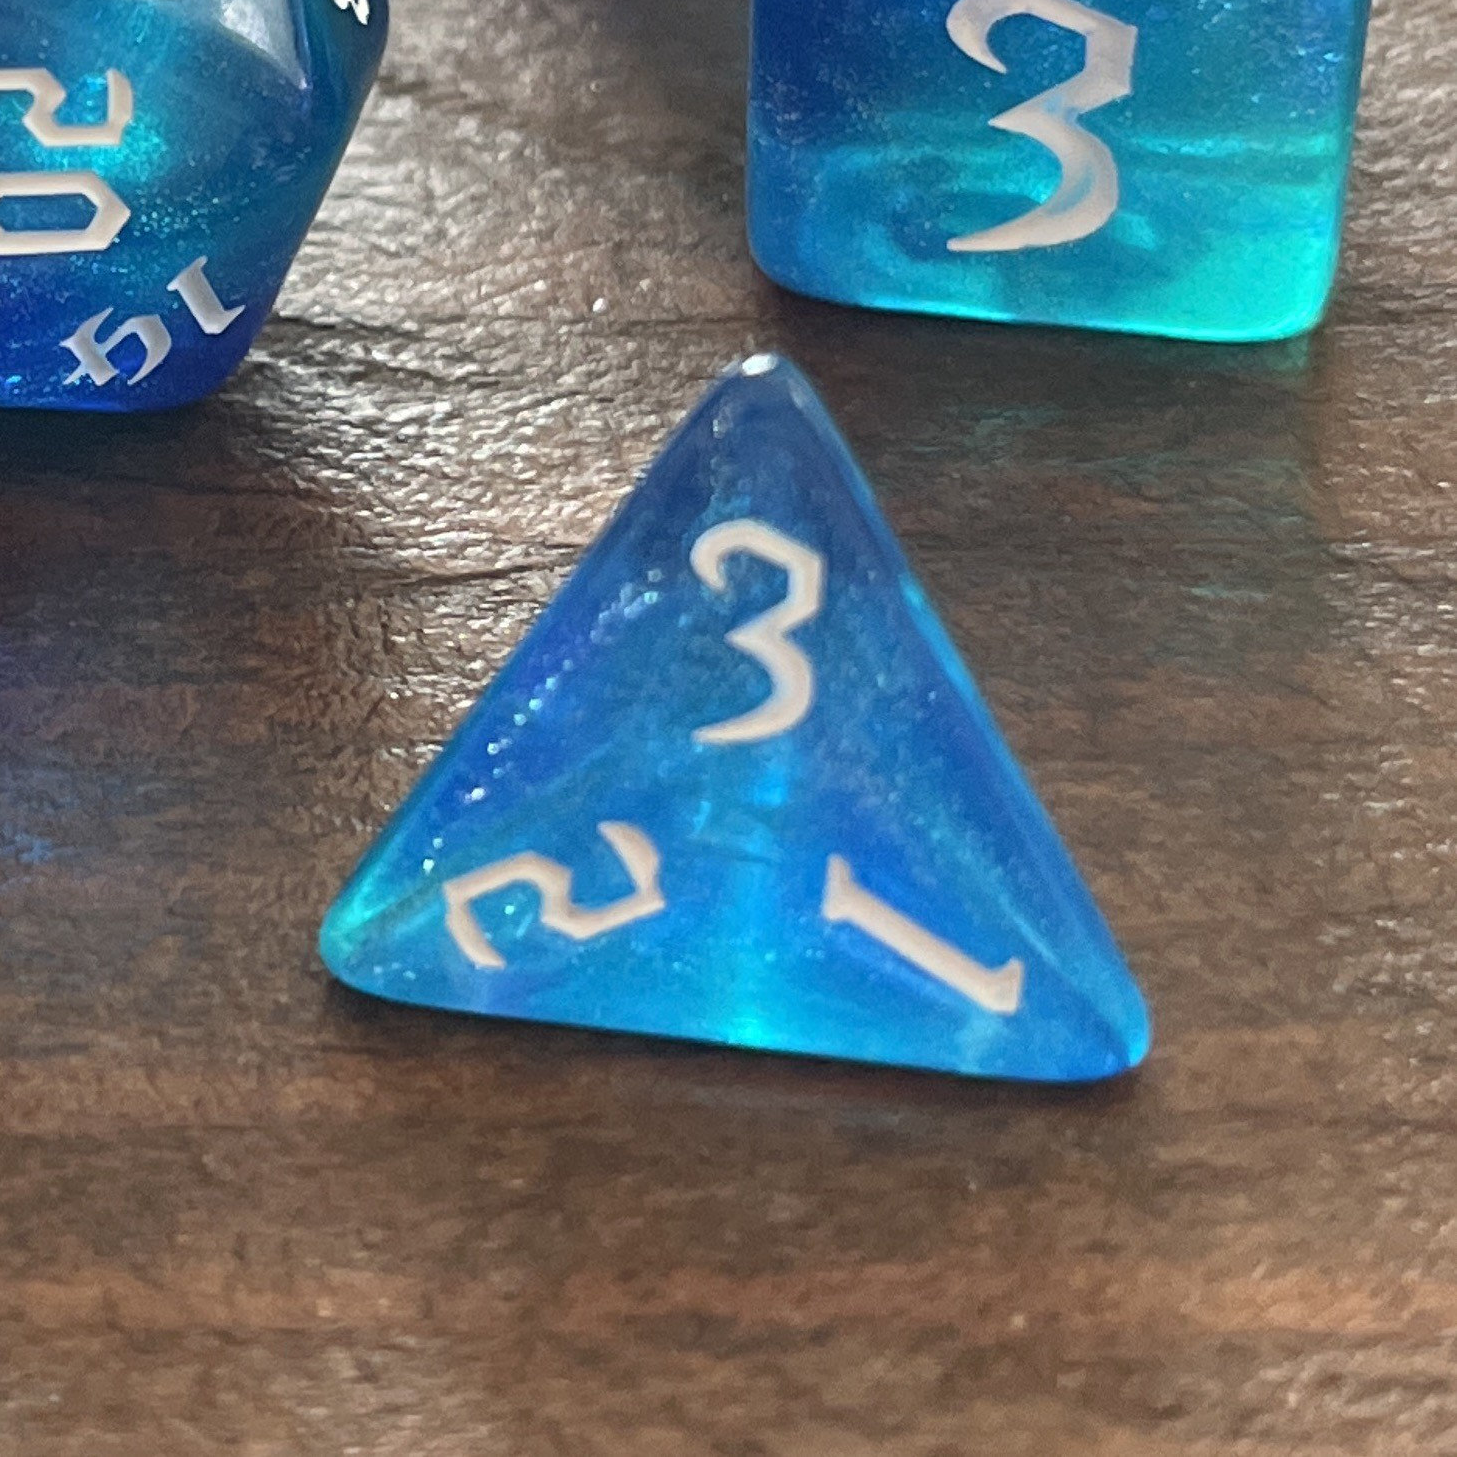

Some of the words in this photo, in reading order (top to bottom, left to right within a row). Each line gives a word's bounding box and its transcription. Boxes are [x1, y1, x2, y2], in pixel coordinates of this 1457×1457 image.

[690, 518, 827, 745] 3
[443, 820, 665, 970] 2
[822, 853, 1024, 1016] 1
